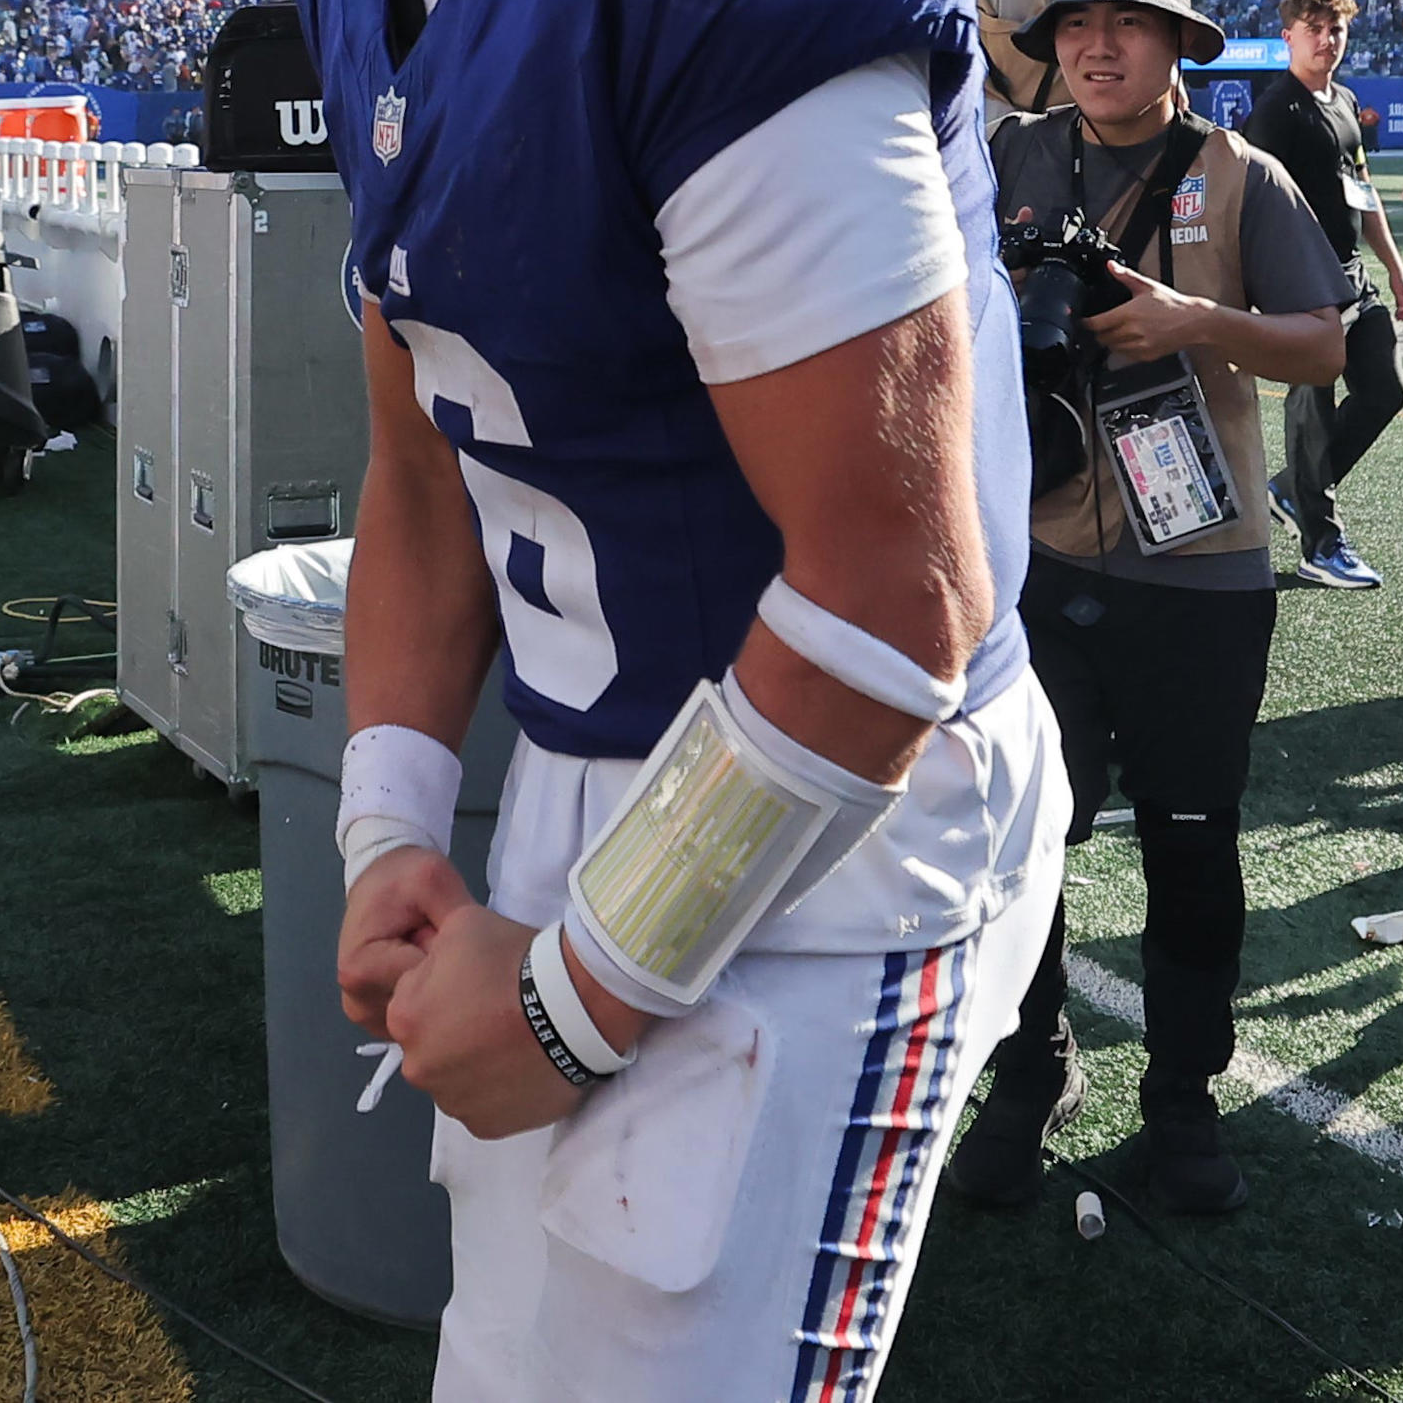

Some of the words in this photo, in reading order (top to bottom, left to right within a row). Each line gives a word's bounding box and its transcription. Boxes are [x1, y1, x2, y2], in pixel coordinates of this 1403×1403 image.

[377, 125, 397, 150] NFL
[254, 209, 269, 233] 2
[1171, 193, 1201, 217] NFL
[389, 318, 619, 712] 6
[259, 640, 341, 687] BRUTE
[522, 990, 556, 1044] HYPE
[549, 1045, 587, 1085] OVER
